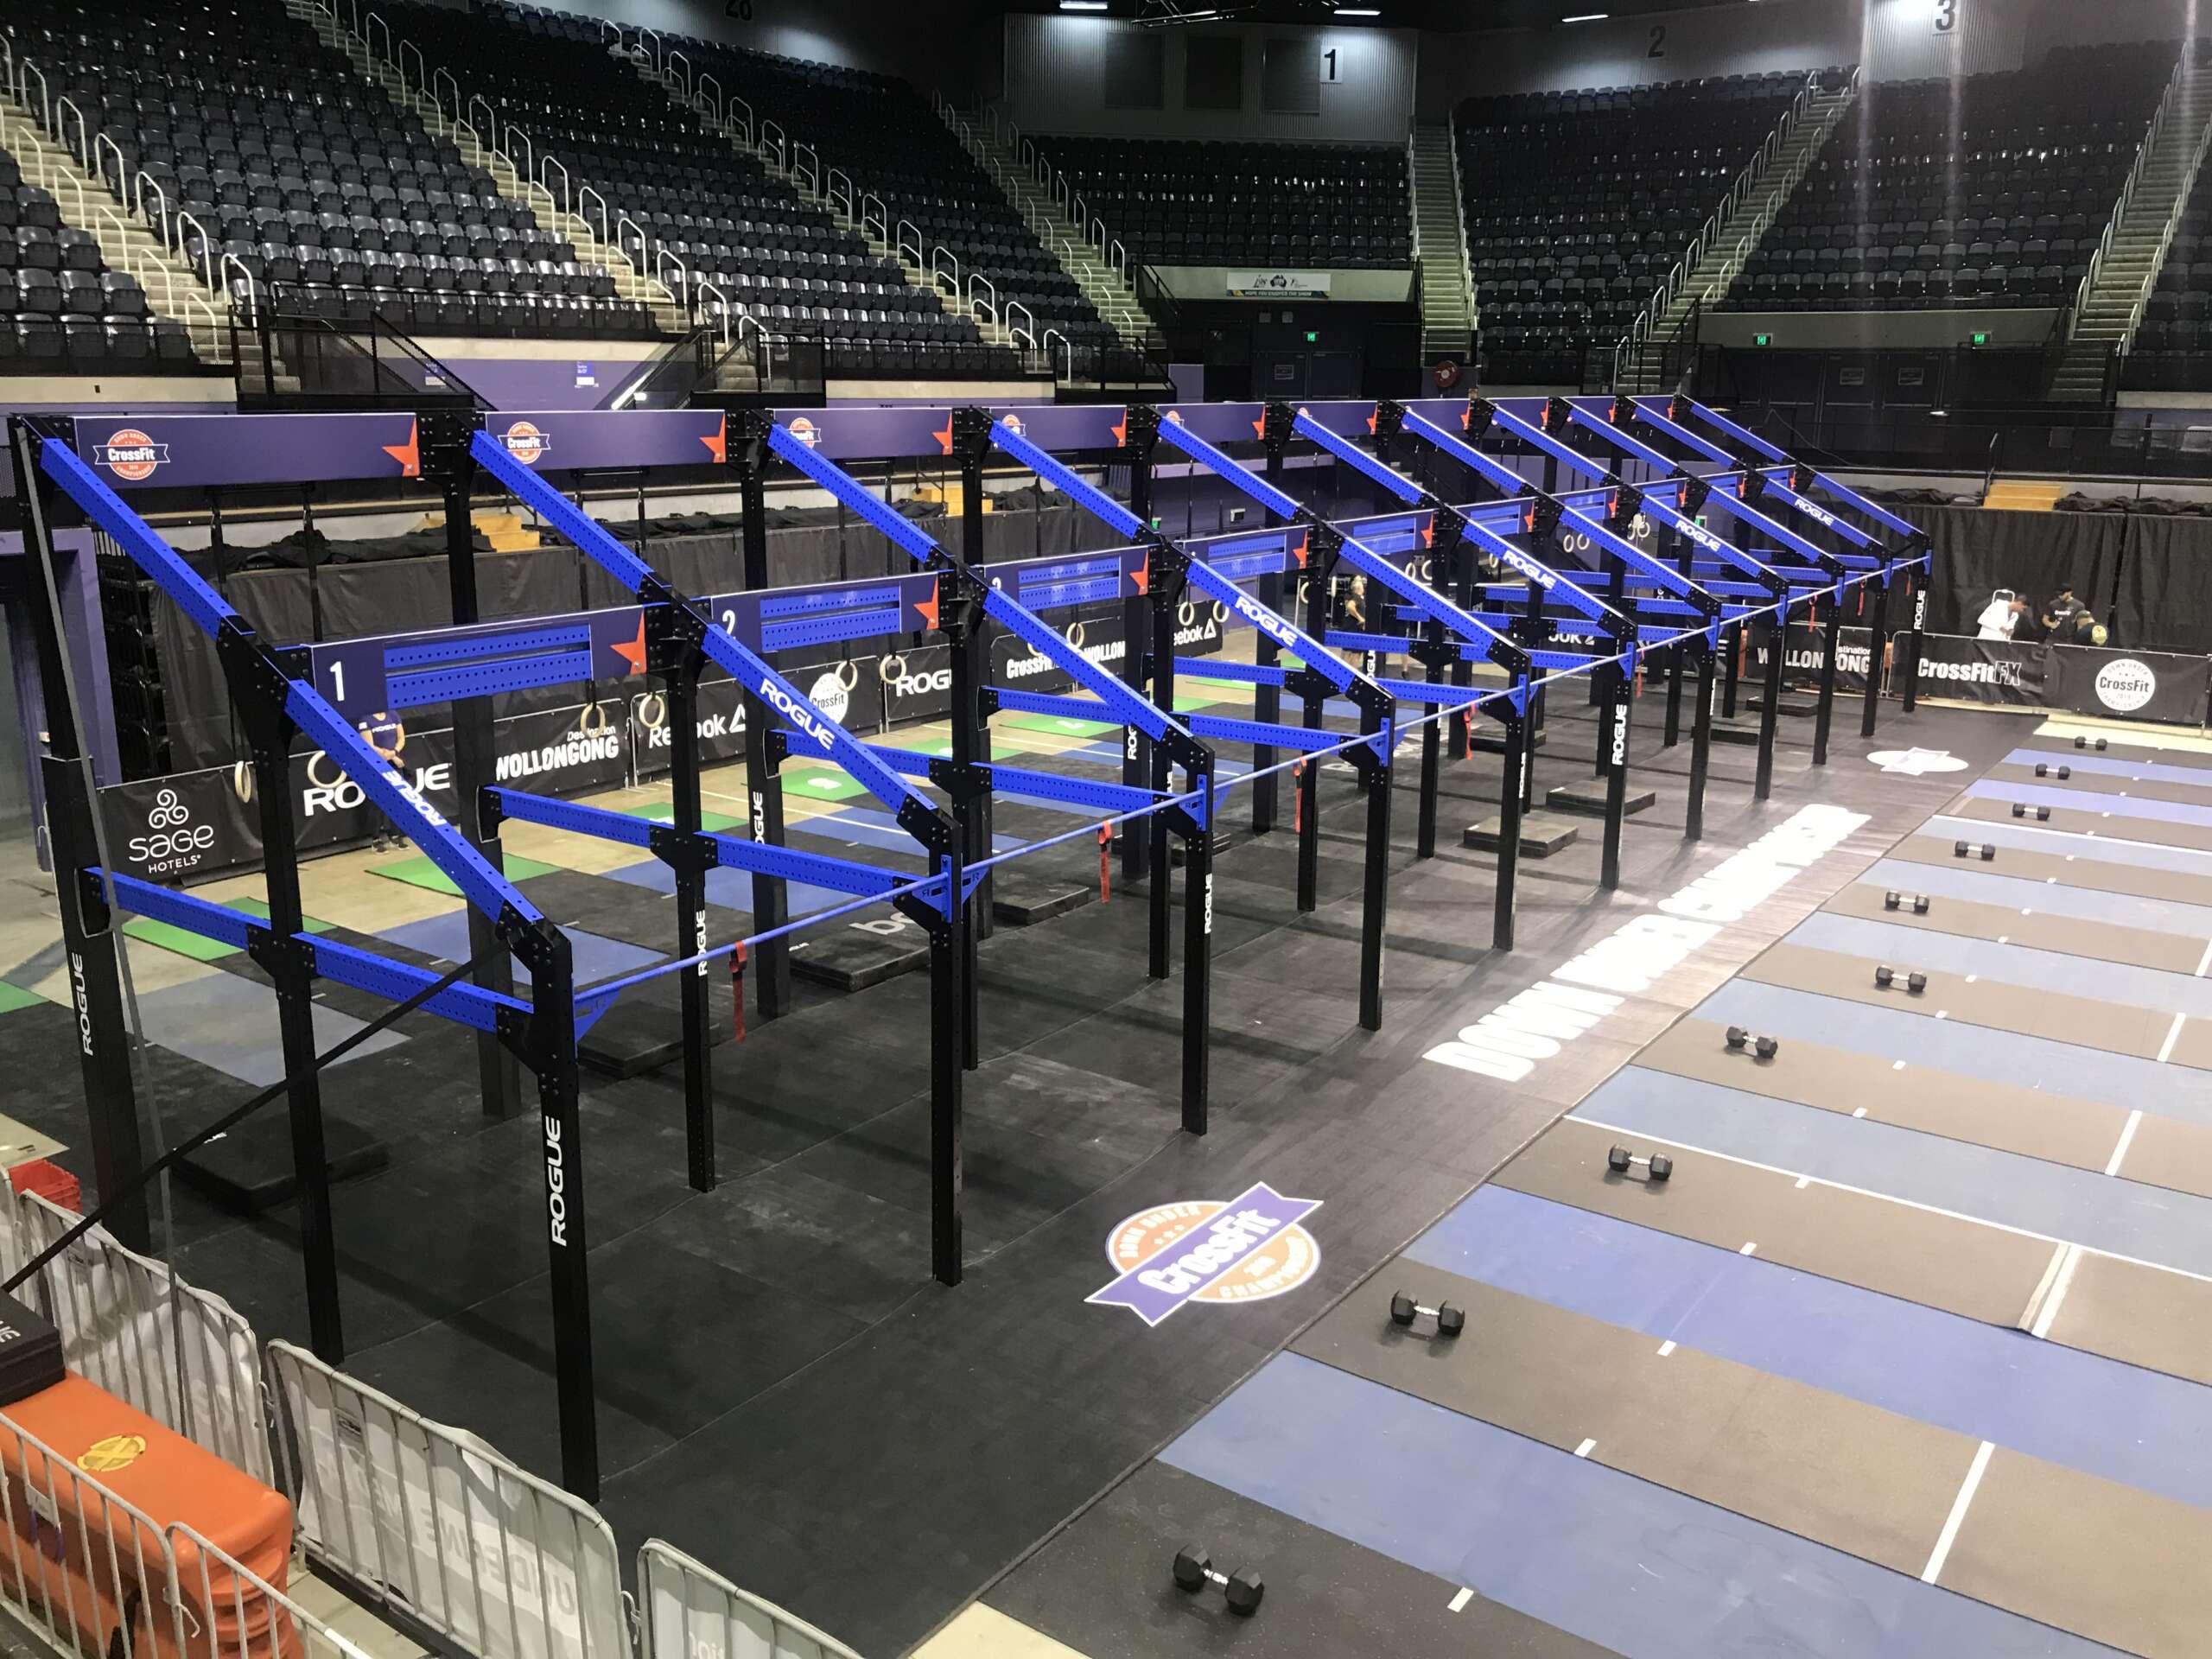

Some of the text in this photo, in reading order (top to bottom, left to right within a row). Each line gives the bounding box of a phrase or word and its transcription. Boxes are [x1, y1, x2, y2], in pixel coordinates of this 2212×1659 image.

[1936, 0, 1956, 31] 3
[1648, 26, 1666, 58] 2
[1324, 48, 1336, 80] 1
[108, 447, 156, 461] CrossFit
[1795, 499, 1834, 526] ROGUE
[1675, 520, 1721, 553] ROGUE
[1503, 550, 1556, 591] ROGUE
[1235, 595, 1298, 647] ROGUE
[1914, 589, 1926, 630] ROGUE
[1758, 647, 1870, 674] WLLONONG
[1838, 645, 1871, 656] stination
[330, 661, 345, 702] 1
[896, 669, 952, 697] ROG
[2099, 677, 2150, 693] CrossFit
[648, 713, 727, 749] Reok
[760, 678, 836, 750] ROGUE
[1611, 704, 1628, 766] ROGUE
[303, 763, 451, 817] ROE
[382, 769, 448, 827] ROGUE
[696, 909, 709, 976] RGUE
[72, 951, 94, 1057] ROGUE
[545, 1115, 567, 1247] ROGUE
[1137, 1208, 1281, 1295] CrossFit
